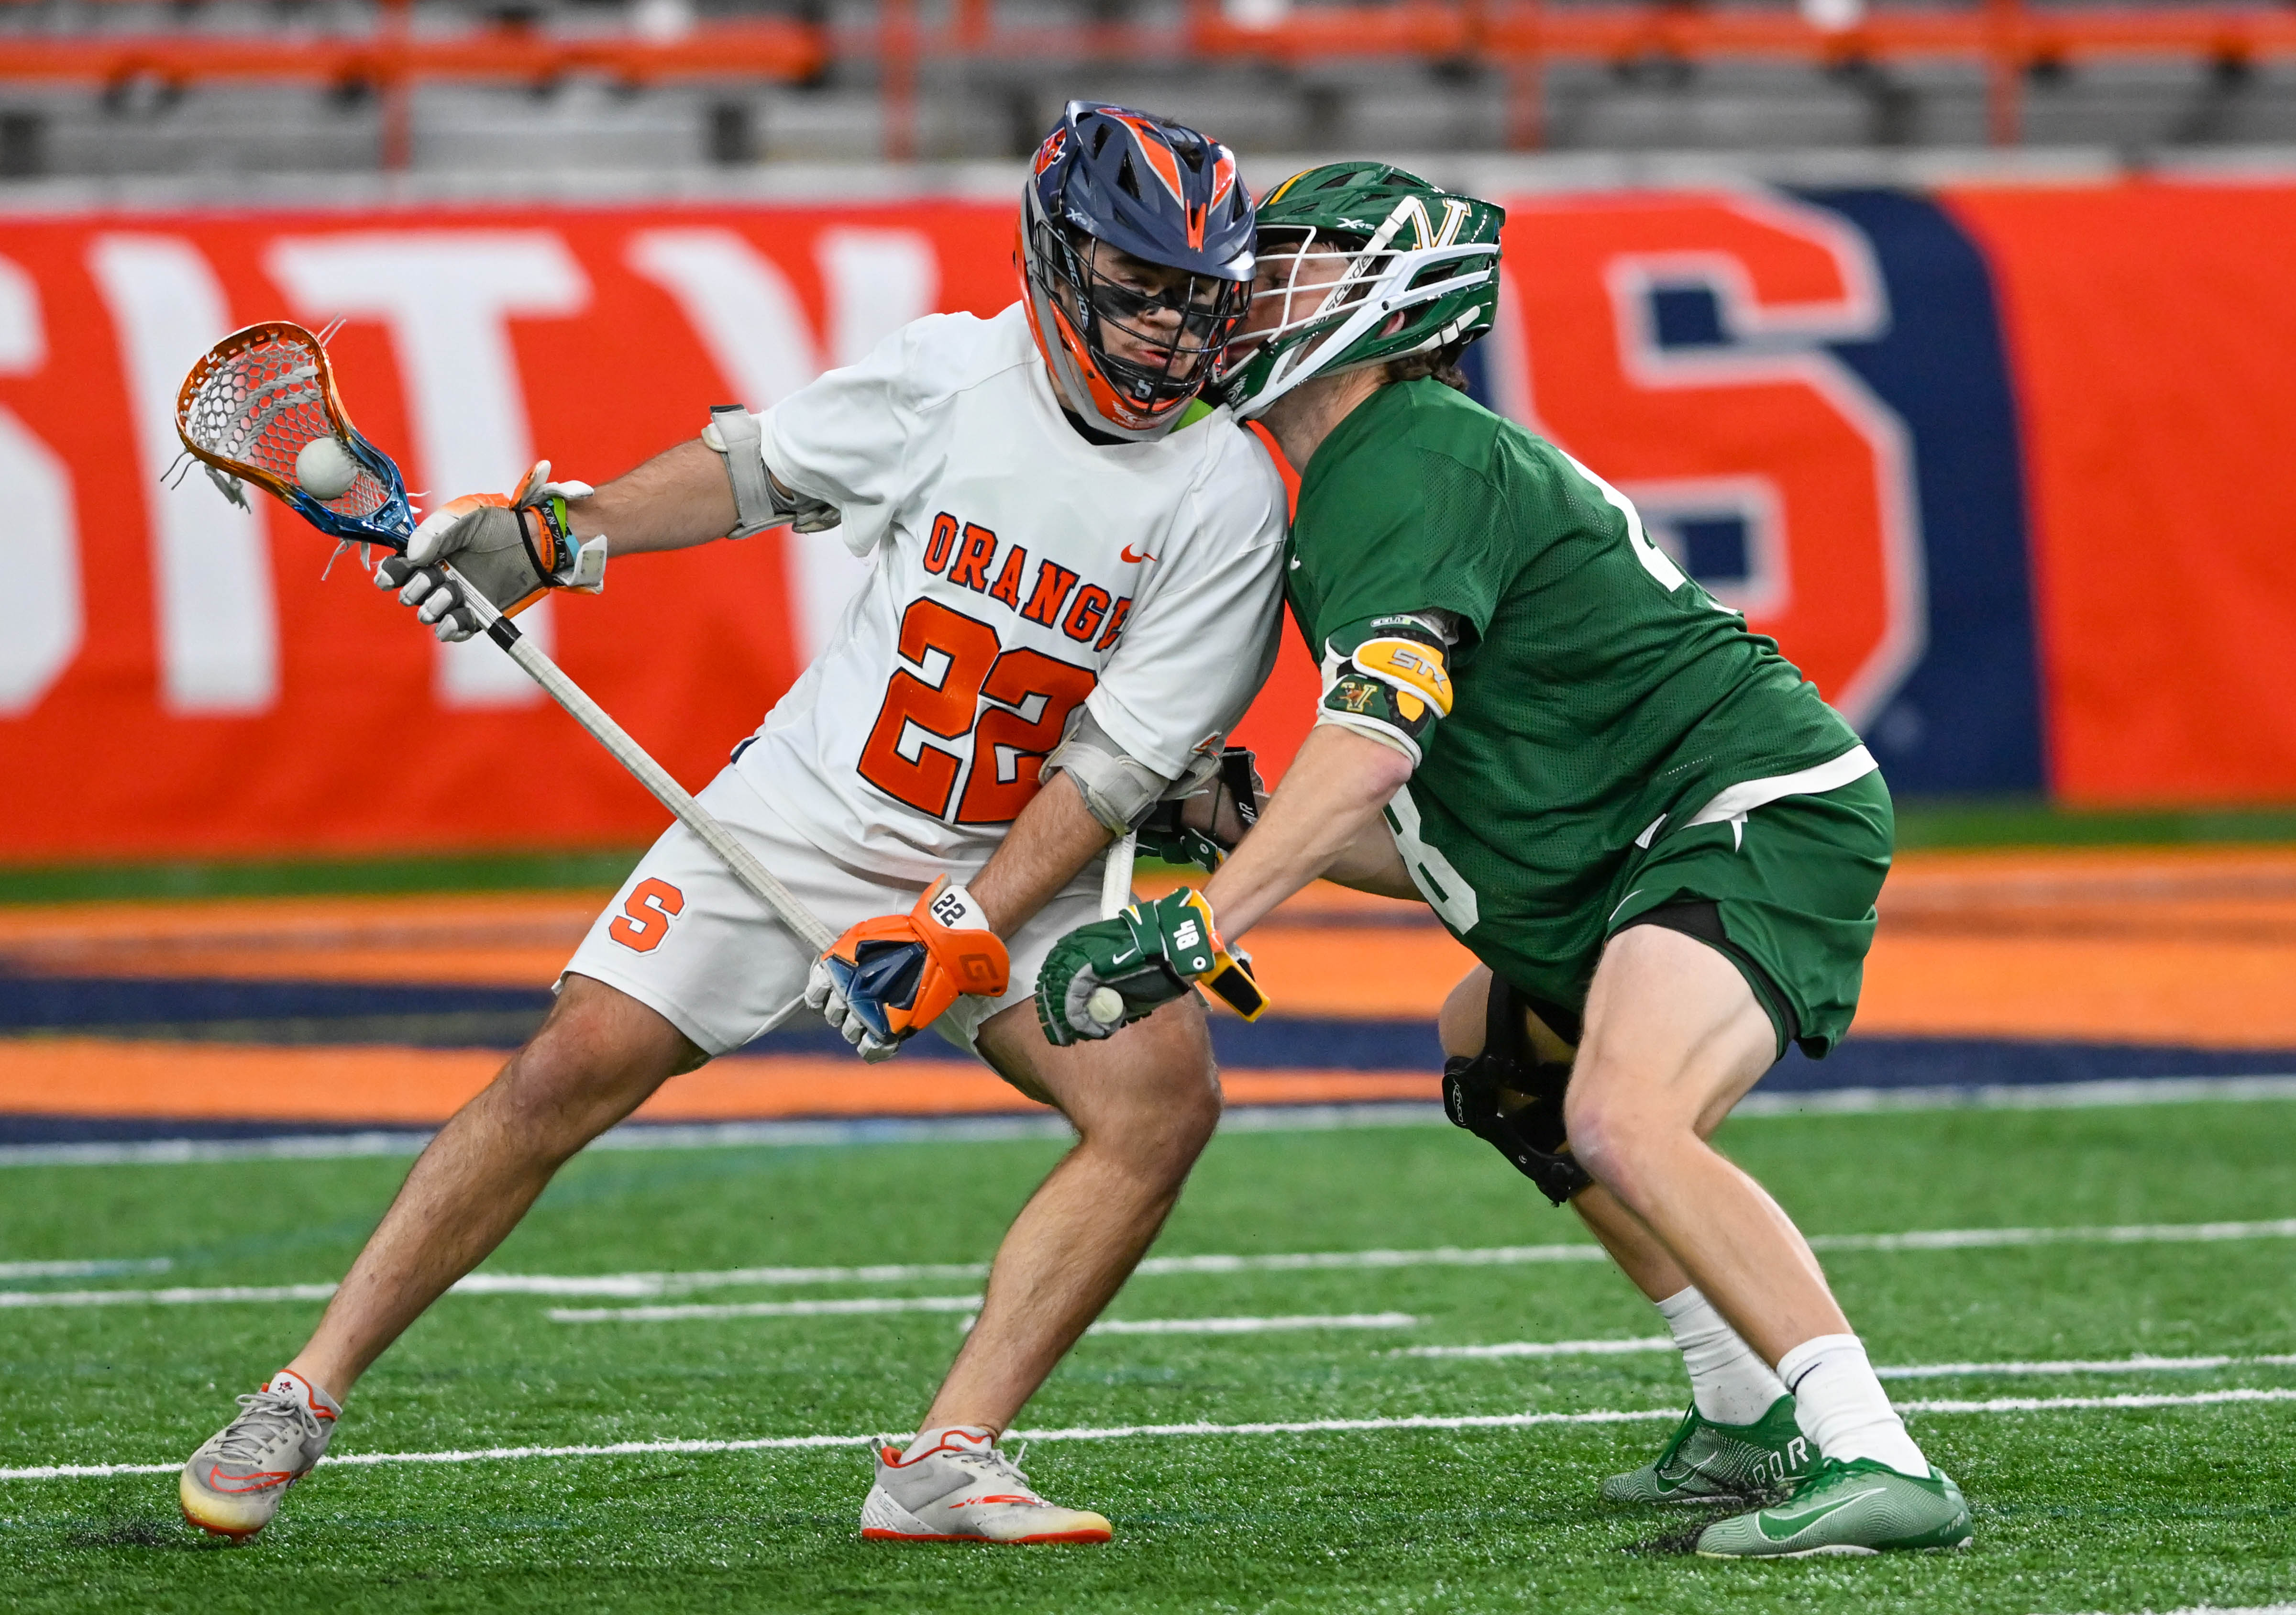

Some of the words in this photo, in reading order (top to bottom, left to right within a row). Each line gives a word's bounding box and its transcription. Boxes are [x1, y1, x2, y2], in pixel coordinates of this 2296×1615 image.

[923, 511, 1133, 652] ORANGE
[1388, 648, 1447, 694] STX
[857, 596, 1099, 825] 22
[608, 876, 685, 953] S
[932, 893, 966, 927] 22
[1173, 918, 1200, 951] 48
[1744, 1436, 1810, 1488] POR
